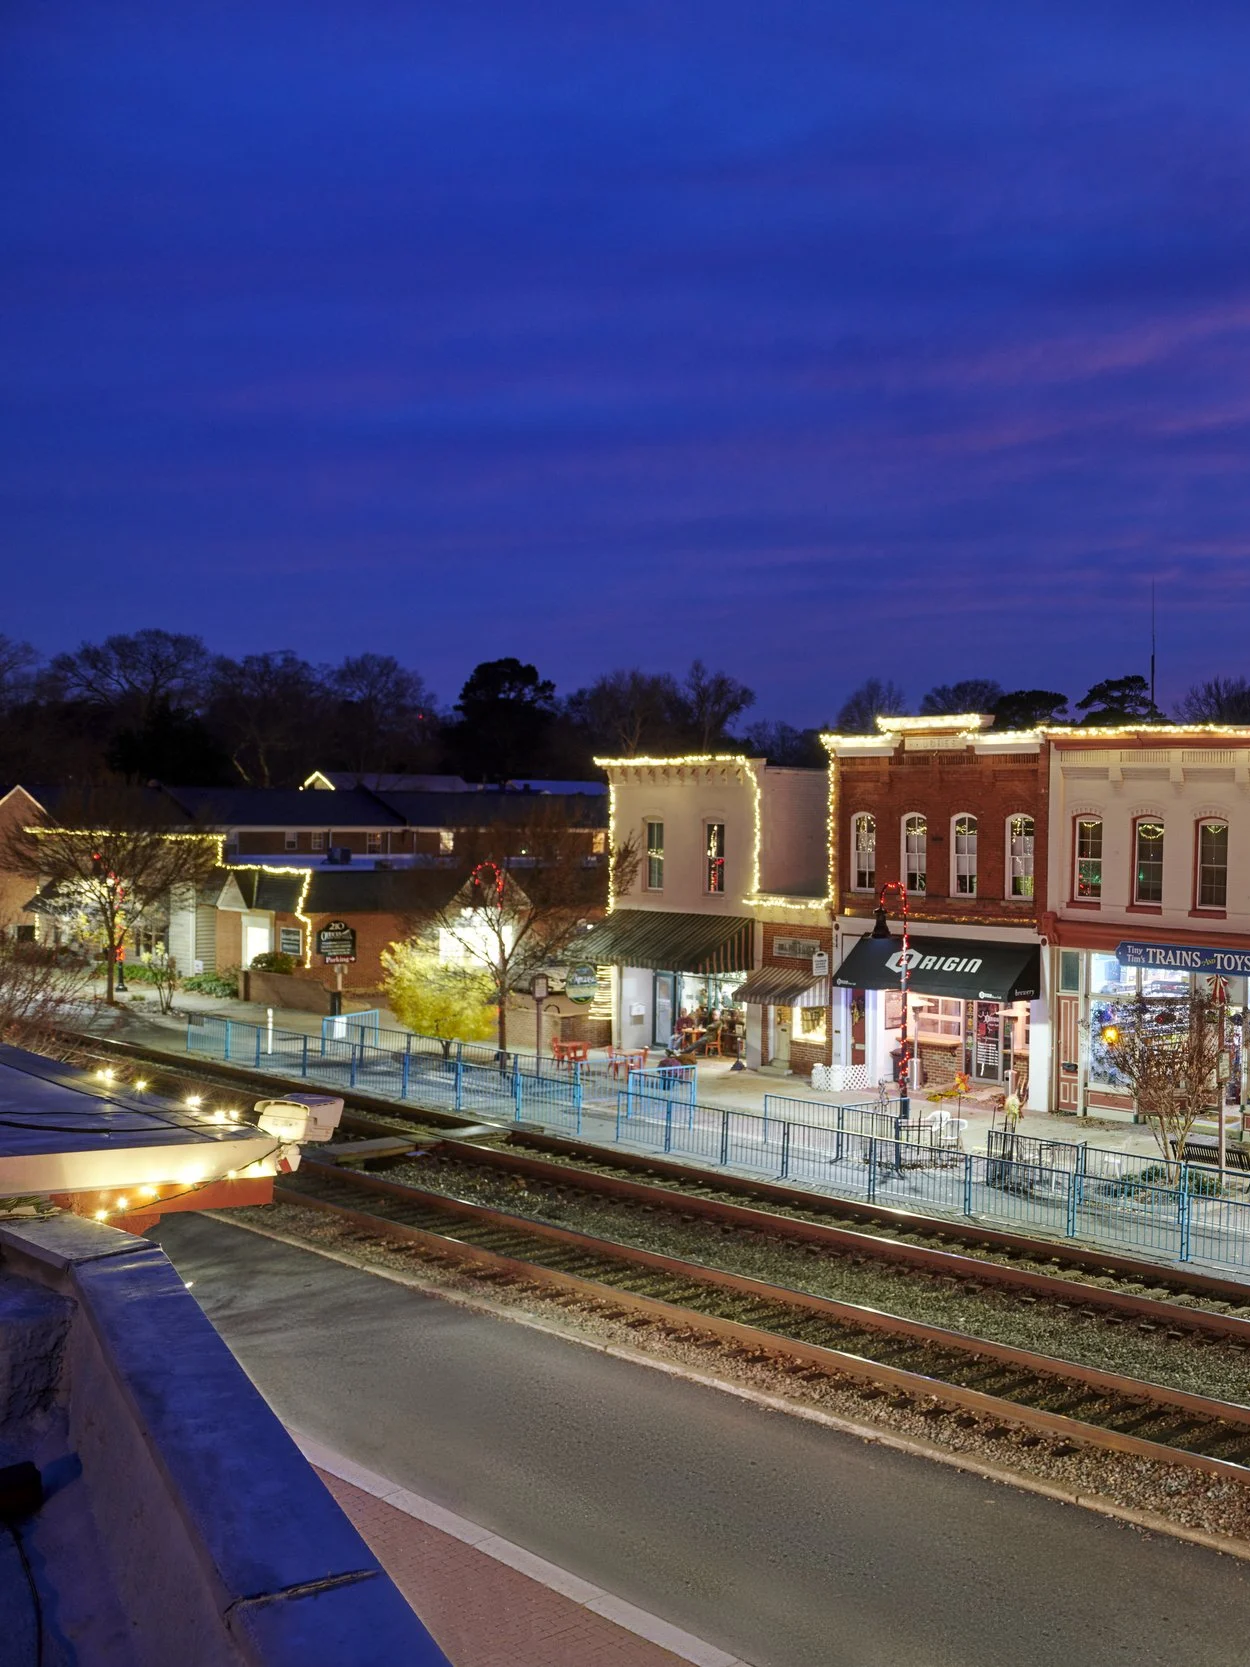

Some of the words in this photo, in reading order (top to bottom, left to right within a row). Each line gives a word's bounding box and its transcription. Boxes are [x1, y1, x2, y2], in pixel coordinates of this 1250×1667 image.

[1127, 945, 1143, 955] Tiny
[885, 948, 983, 973] ORIGIN
[1127, 954, 1146, 964] Tim's
[1146, 948, 1201, 968] TRAINS
[1014, 989, 1035, 997] brewery
